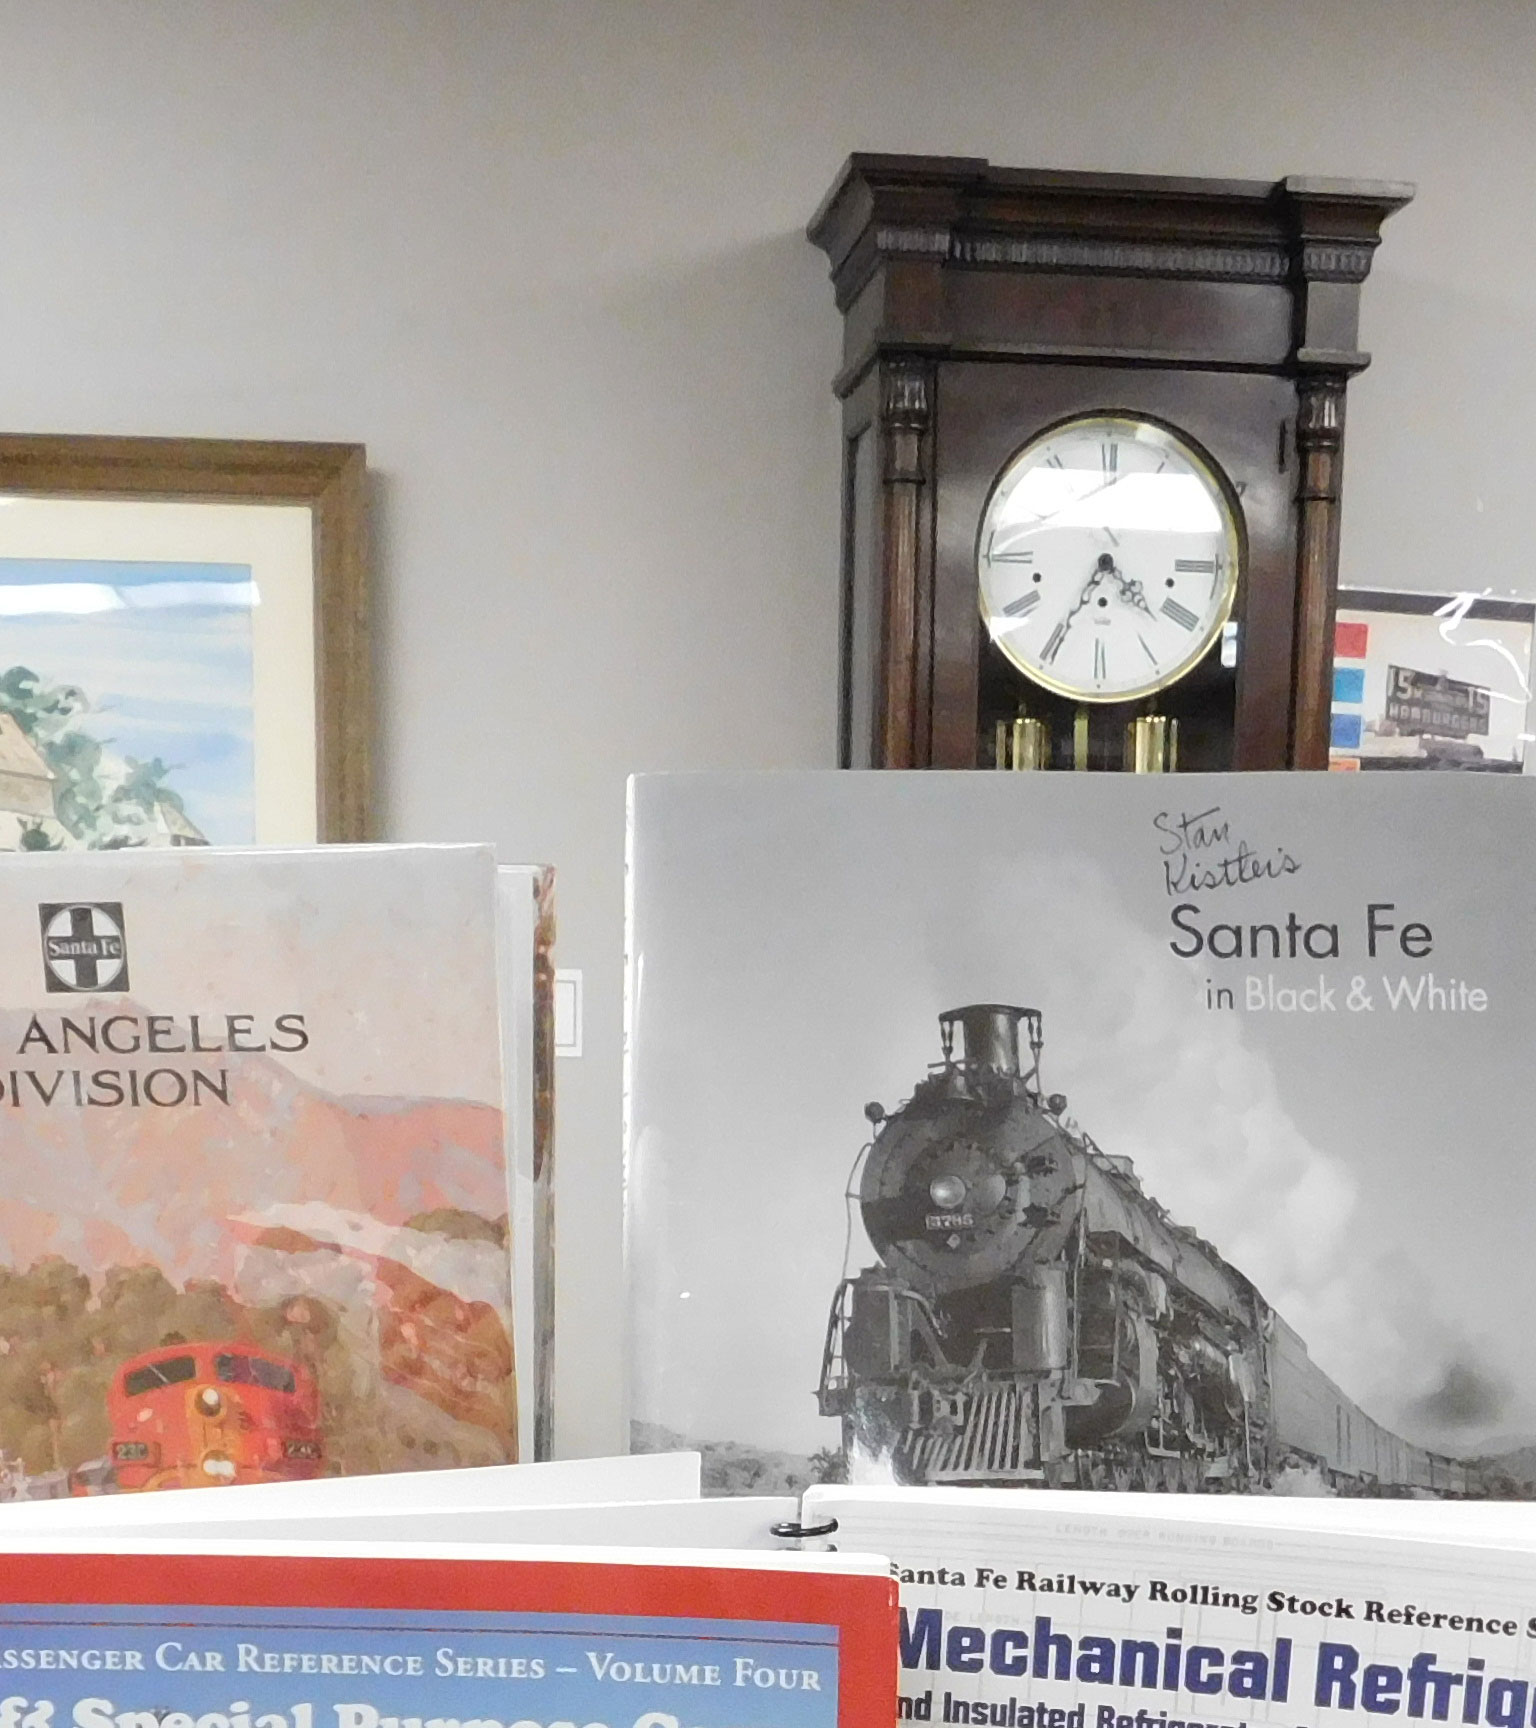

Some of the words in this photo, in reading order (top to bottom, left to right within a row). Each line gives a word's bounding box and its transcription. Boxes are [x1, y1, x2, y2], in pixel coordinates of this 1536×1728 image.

[1153, 806, 1229, 855] Stan
[48, 938, 98, 957] Santa
[100, 939, 121, 956] Fe
[1170, 903, 1340, 959] Santa
[1367, 903, 1434, 958] Fe
[1206, 978, 1234, 1010] in
[1245, 974, 1337, 1013] Black
[1346, 975, 1375, 1013] &
[1382, 973, 1489, 1012] White
[16, 1013, 310, 1055] ANGELES
[974, 1568, 1007, 1590] Fe
[1016, 1571, 1141, 1603] Railway
[1148, 1580, 1260, 1615] Rolling
[1266, 1591, 1356, 1621] Stock
[1364, 1600, 1518, 1637] Reference
[155, 1642, 226, 1673] CAR
[236, 1643, 425, 1676] REFERENCE
[435, 1647, 546, 1679] SERIES
[585, 1651, 722, 1686] VOLUME
[732, 1657, 822, 1692] FOUR
[898, 1606, 1293, 1703] Mechanical
[896, 1690, 932, 1722] nd
